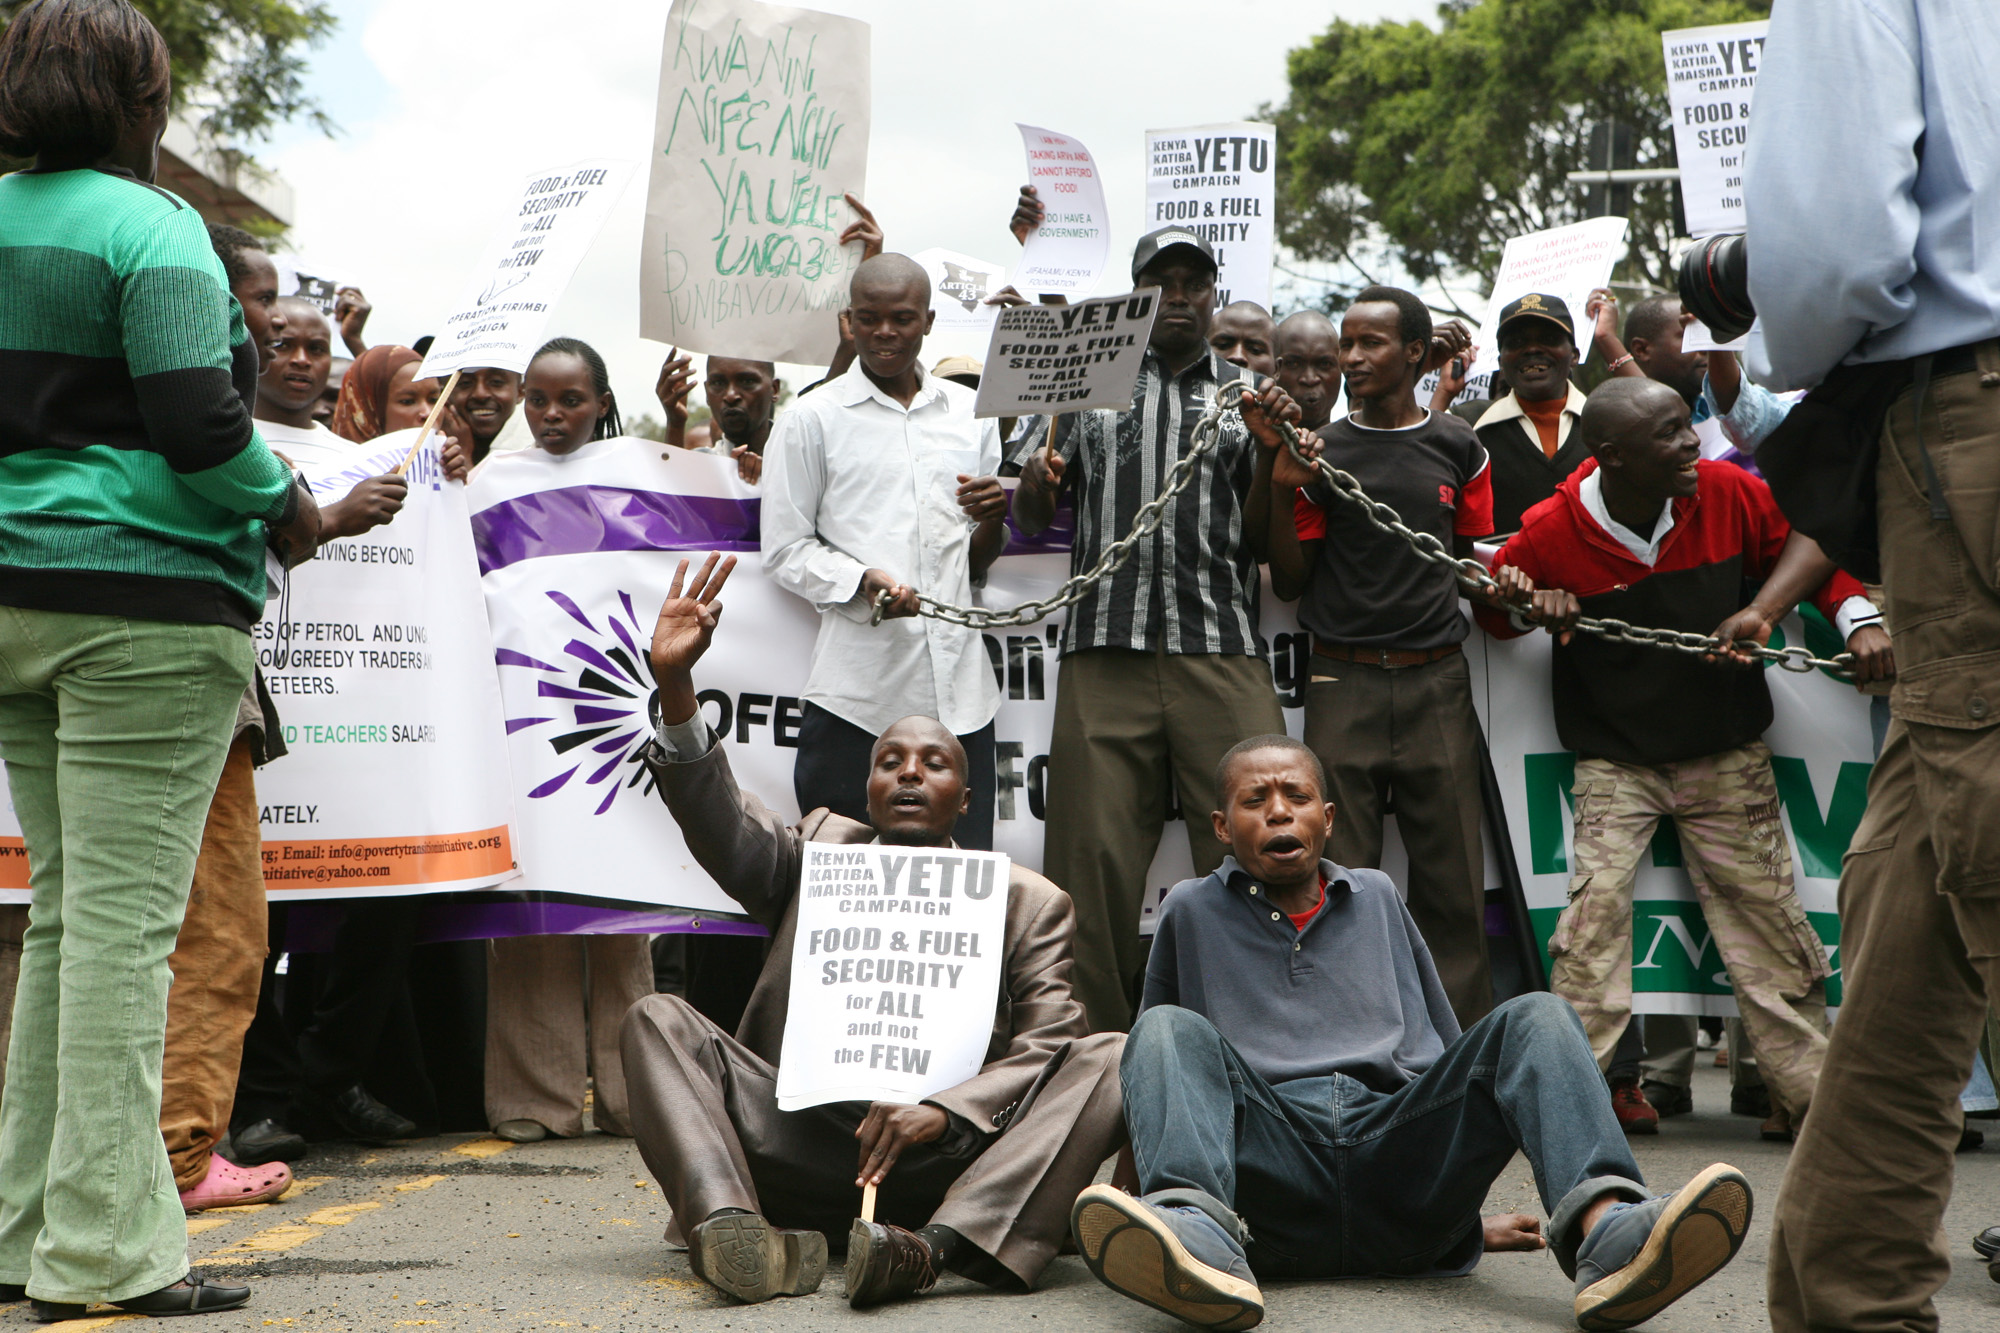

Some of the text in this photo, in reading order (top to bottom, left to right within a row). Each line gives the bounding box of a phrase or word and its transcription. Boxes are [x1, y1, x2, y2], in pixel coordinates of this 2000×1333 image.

[1671, 44, 1709, 56] KENYA
[1673, 56, 1717, 69] KATIBA
[1675, 68, 1723, 81] MAISHA
[1699, 76, 1757, 92] CAMPAI
[1684, 103, 1733, 125] FOOD
[1154, 140, 1187, 151] KENYA
[1030, 150, 1056, 160] TAKING
[1074, 152, 1089, 161] AND
[1154, 152, 1192, 164] KATIBA
[1195, 137, 1268, 173] YETU
[1721, 156, 1738, 168] for
[1033, 167, 1092, 178] CANNOT AFFORD
[1153, 165, 1196, 177] MAISHA
[525, 169, 608, 197] FOOD & FUEL
[1173, 176, 1240, 189] CAMPAIGN
[1726, 177, 1743, 187] an
[519, 191, 588, 216] SECURITY
[1156, 198, 1262, 221] FOOD & FUEL
[1722, 197, 1741, 209] the
[520, 214, 557, 233] for ALL
[1048, 214, 1058, 223] DO
[1065, 214, 1084, 223] HAVE
[1086, 214, 1092, 223] A
[1039, 228, 1099, 238] GOVERNMENT?
[512, 235, 546, 250] and not
[1540, 239, 1560, 251] AM
[499, 250, 544, 269] the FEW
[1510, 255, 1549, 270] TAKING
[1583, 241, 1609, 250] AND
[1065, 269, 1091, 277] KENYA
[1507, 254, 1602, 283] CANNOT AFFORD
[939, 282, 986, 292] ARTICLE
[1029, 278, 1078, 288] FOUNDATION
[959, 290, 976, 301] 43
[448, 303, 548, 324] OPERATION FIRIMBI
[1061, 296, 1153, 330] YETU
[457, 322, 509, 340] CAMPAIGN
[1026, 325, 1115, 339] CAMPAIGN
[474, 342, 518, 351] CORRUPTION
[1000, 335, 1136, 356] FOOD & FUEL
[1009, 350, 1121, 369] SECURITY
[1029, 368, 1088, 381] for ALL
[1468, 374, 1489, 388] UEL
[1029, 381, 1083, 391] and not
[1018, 388, 1092, 403] the FEW
[313, 543, 414, 565] LIVING BEYOND
[280, 622, 301, 640] OF
[306, 624, 364, 642] PETROL
[373, 625, 402, 642] AND
[291, 650, 354, 668] GREEDY
[360, 651, 422, 670] TRADERS
[265, 676, 339, 695] ETEERS.
[303, 726, 388, 743] TEACHERS
[258, 805, 320, 824] ATELY.
[283, 845, 325, 860] Email:
[811, 852, 866, 866] KENYA
[809, 869, 874, 882] KATIBA
[880, 855, 996, 900] YETU
[808, 884, 878, 898] MAISHA
[839, 900, 951, 916] CAMPAIGN
[809, 927, 982, 958] FOOD & FUEL
[822, 959, 964, 989] SECURITY
[846, 991, 924, 1019] for ALL
[847, 1021, 918, 1040] and not
[835, 1044, 932, 1076] the FEW
